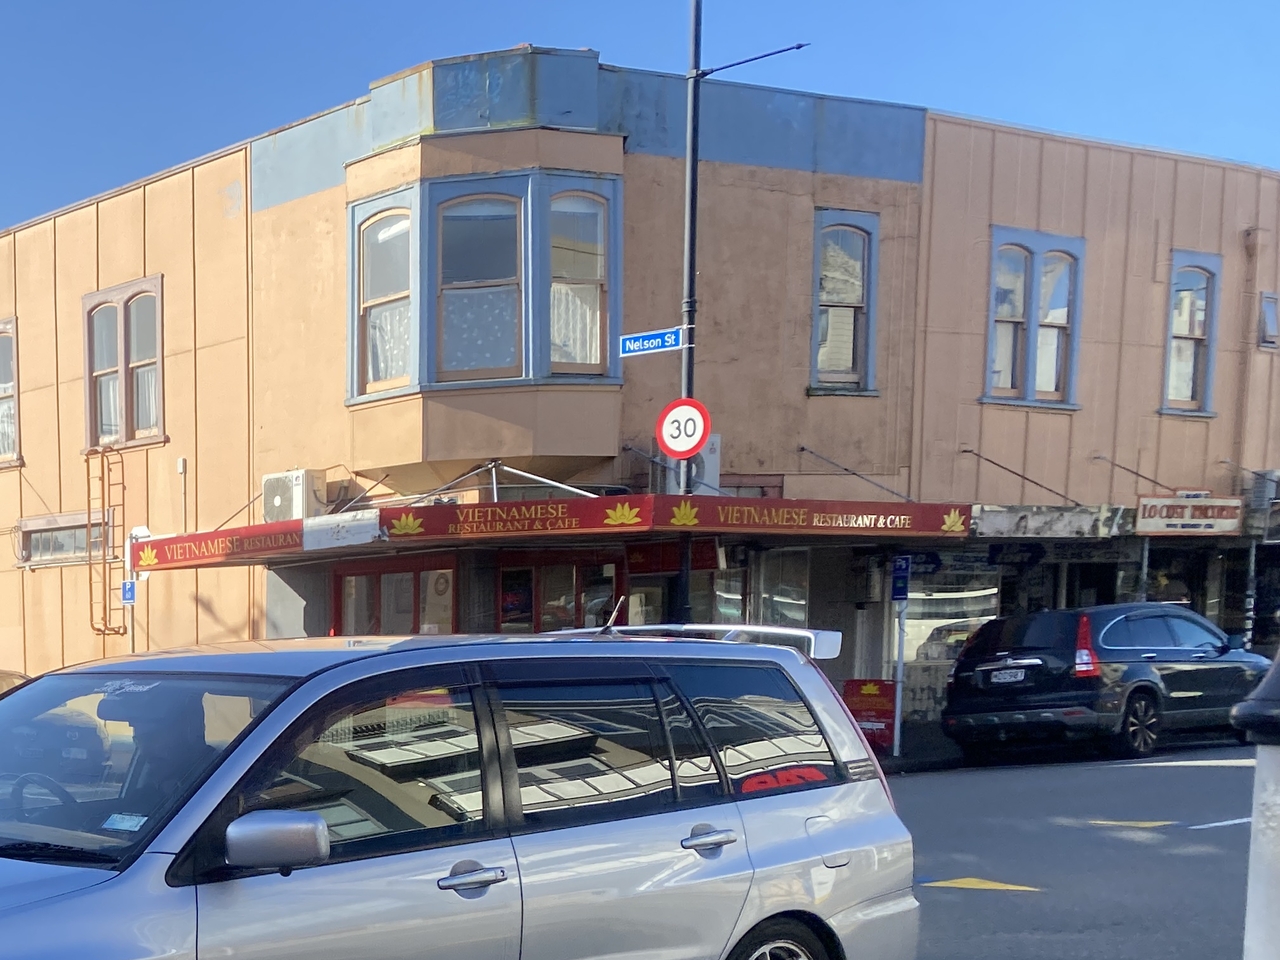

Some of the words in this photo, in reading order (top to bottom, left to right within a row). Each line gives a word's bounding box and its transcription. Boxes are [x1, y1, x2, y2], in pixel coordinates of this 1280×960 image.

[625, 337, 662, 351] Nelson
[664, 333, 676, 346] St
[669, 417, 697, 439] 30
[455, 504, 568, 523] VIETNAMESE
[717, 506, 808, 526] VIETNAMESE
[812, 513, 877, 528] RESTAURANT
[877, 515, 886, 528] &
[886, 514, 912, 528] CAFE
[448, 519, 530, 535] RESTAURANT
[533, 520, 543, 530] &
[546, 517, 580, 531] CAFE
[165, 536, 240, 561] VIETNAMESE
